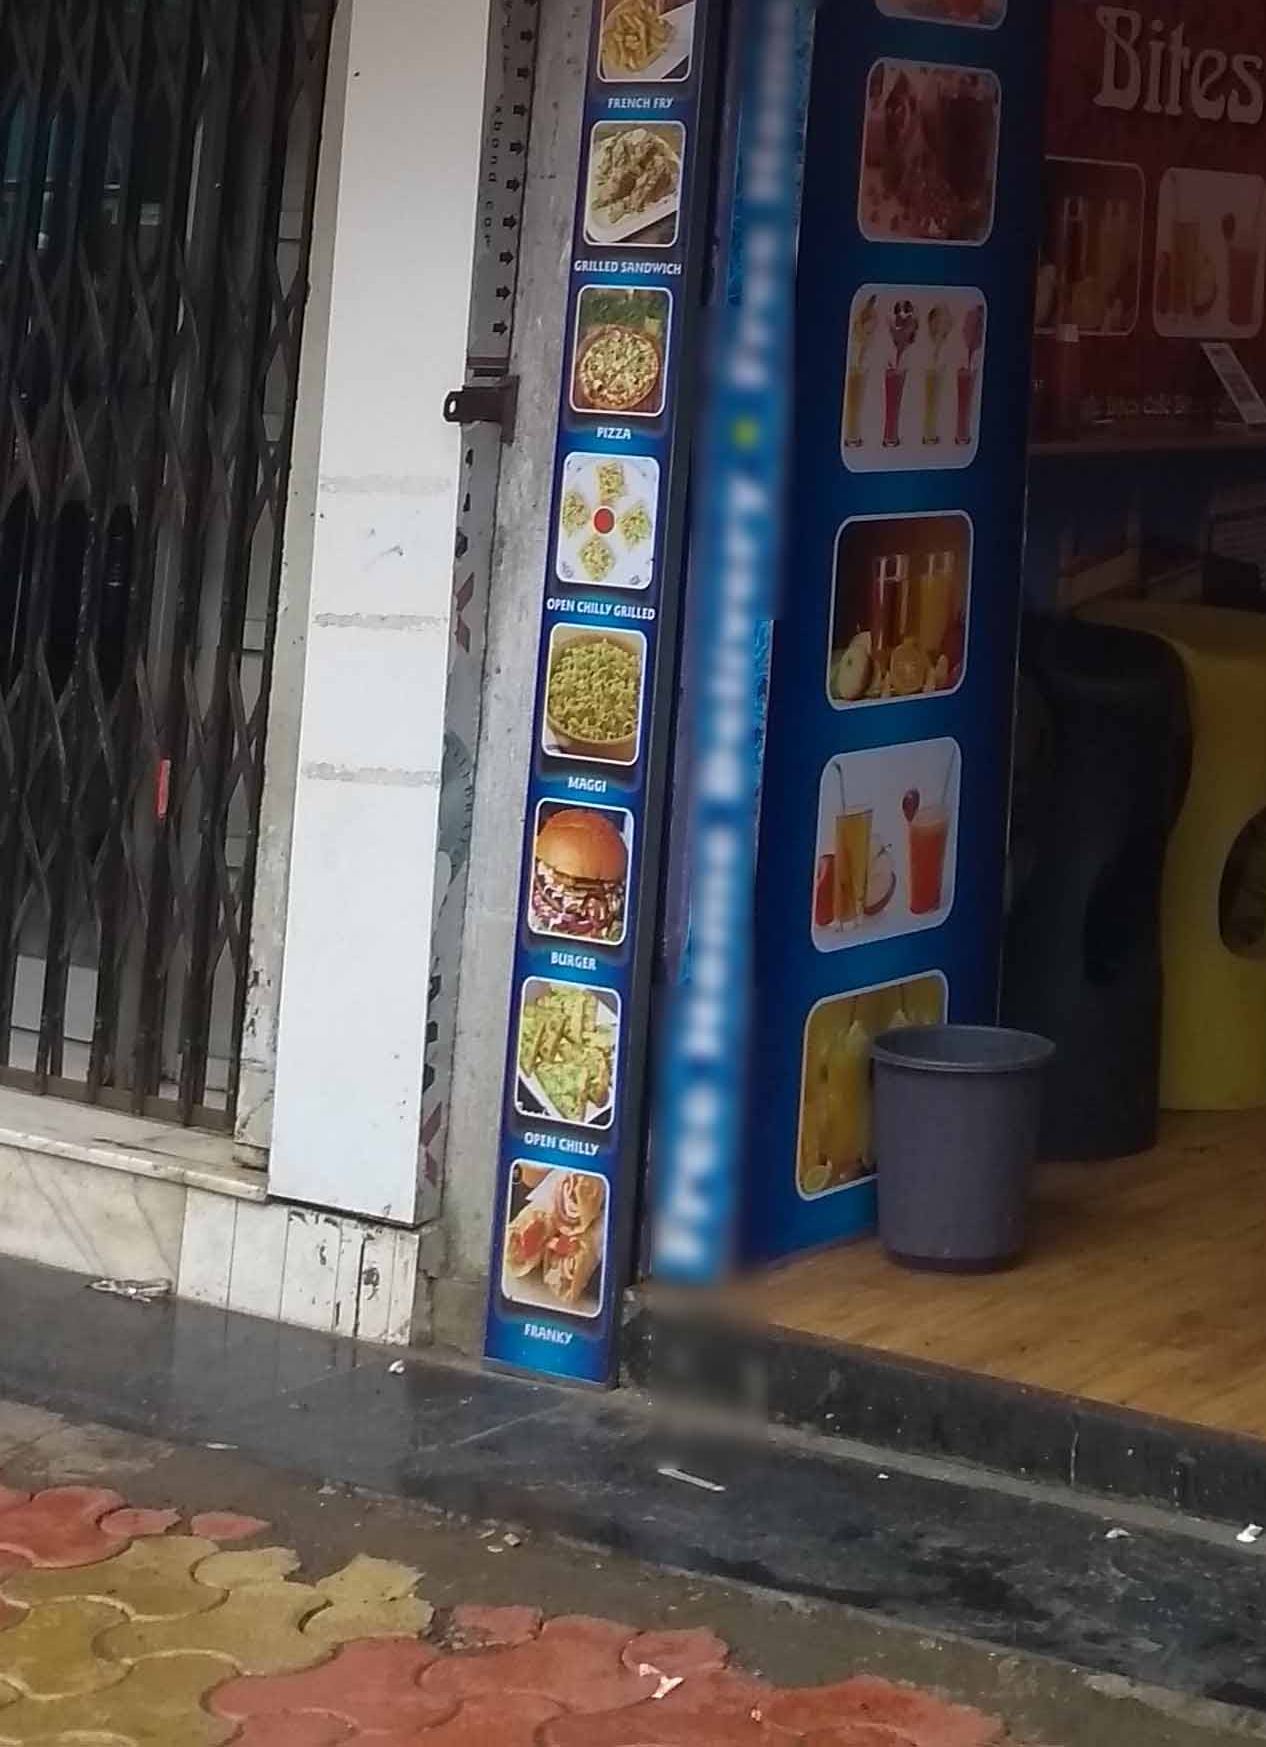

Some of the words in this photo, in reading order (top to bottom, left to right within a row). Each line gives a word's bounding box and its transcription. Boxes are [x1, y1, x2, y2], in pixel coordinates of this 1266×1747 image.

[1092, 5, 1265, 125] Bites
[607, 97, 651, 109] FRENCH
[653, 97, 673, 109] FRY
[574, 259, 619, 273] GRILLED
[620, 261, 682, 275] SANDWICH
[596, 426, 632, 440] PIZZA
[546, 597, 575, 612] OPEN
[576, 601, 612, 615] CHILLY
[613, 604, 656, 620] GRILLED
[567, 776, 607, 793] MAGGI
[550, 951, 597, 971] BURGER
[524, 1131, 557, 1149] OPEN
[558, 1138, 600, 1156] CHILLY
[523, 1323, 574, 1345] FRANKY
